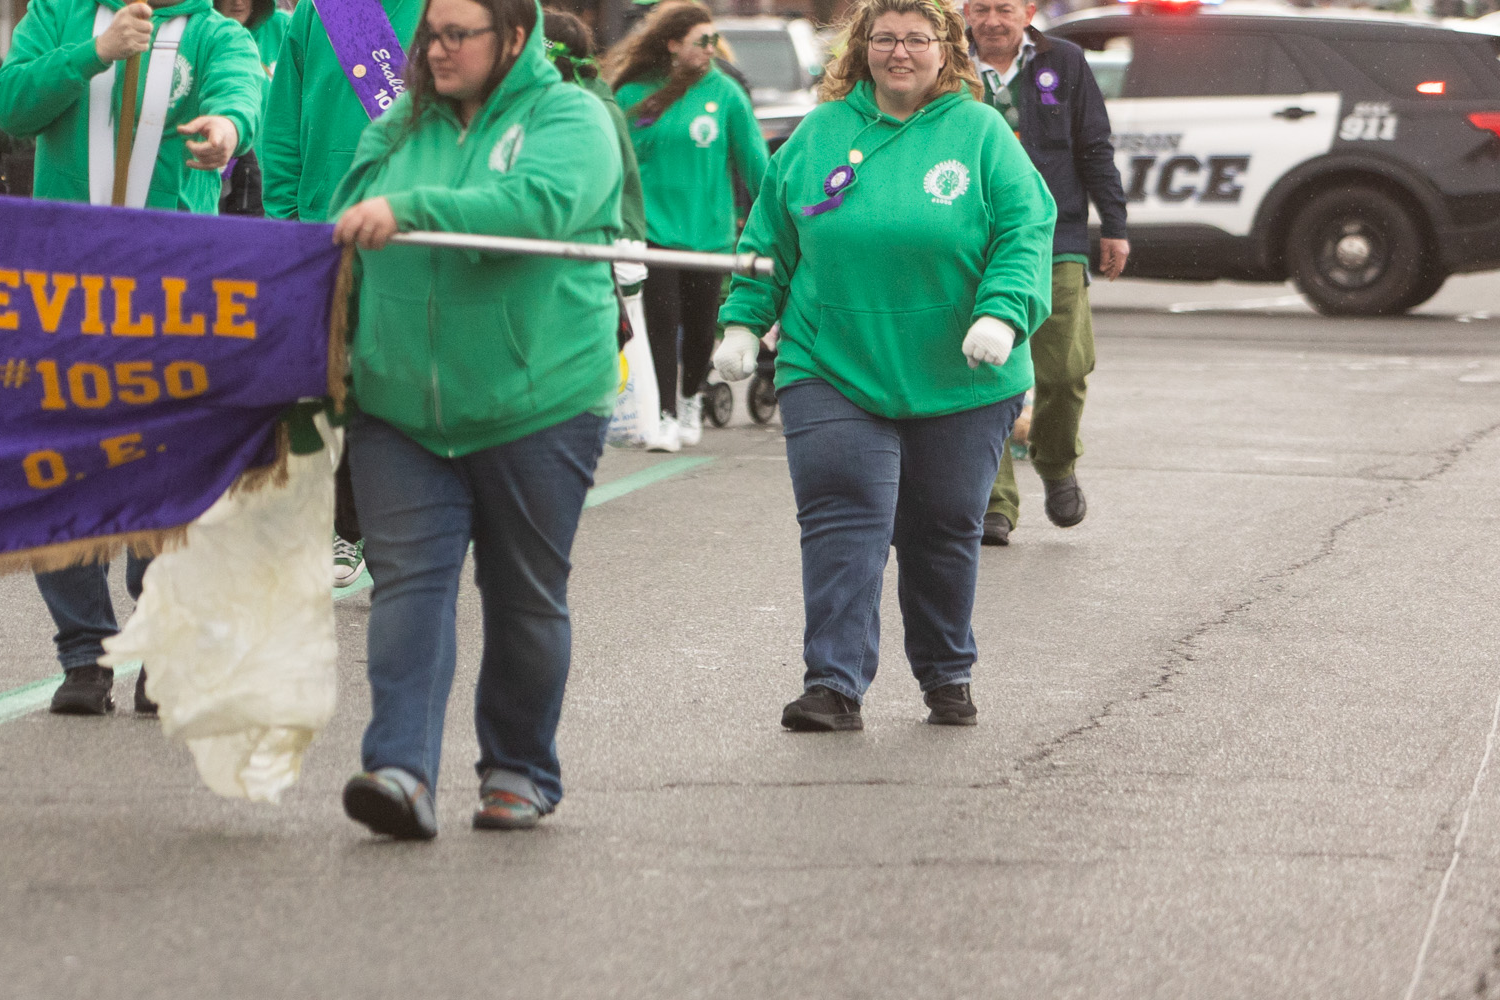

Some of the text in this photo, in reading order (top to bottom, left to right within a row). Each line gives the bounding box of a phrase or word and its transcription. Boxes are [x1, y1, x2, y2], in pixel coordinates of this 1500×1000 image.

[374, 88, 393, 110] 10
[1338, 113, 1398, 141] 911
[1127, 154, 1252, 203] ICE
